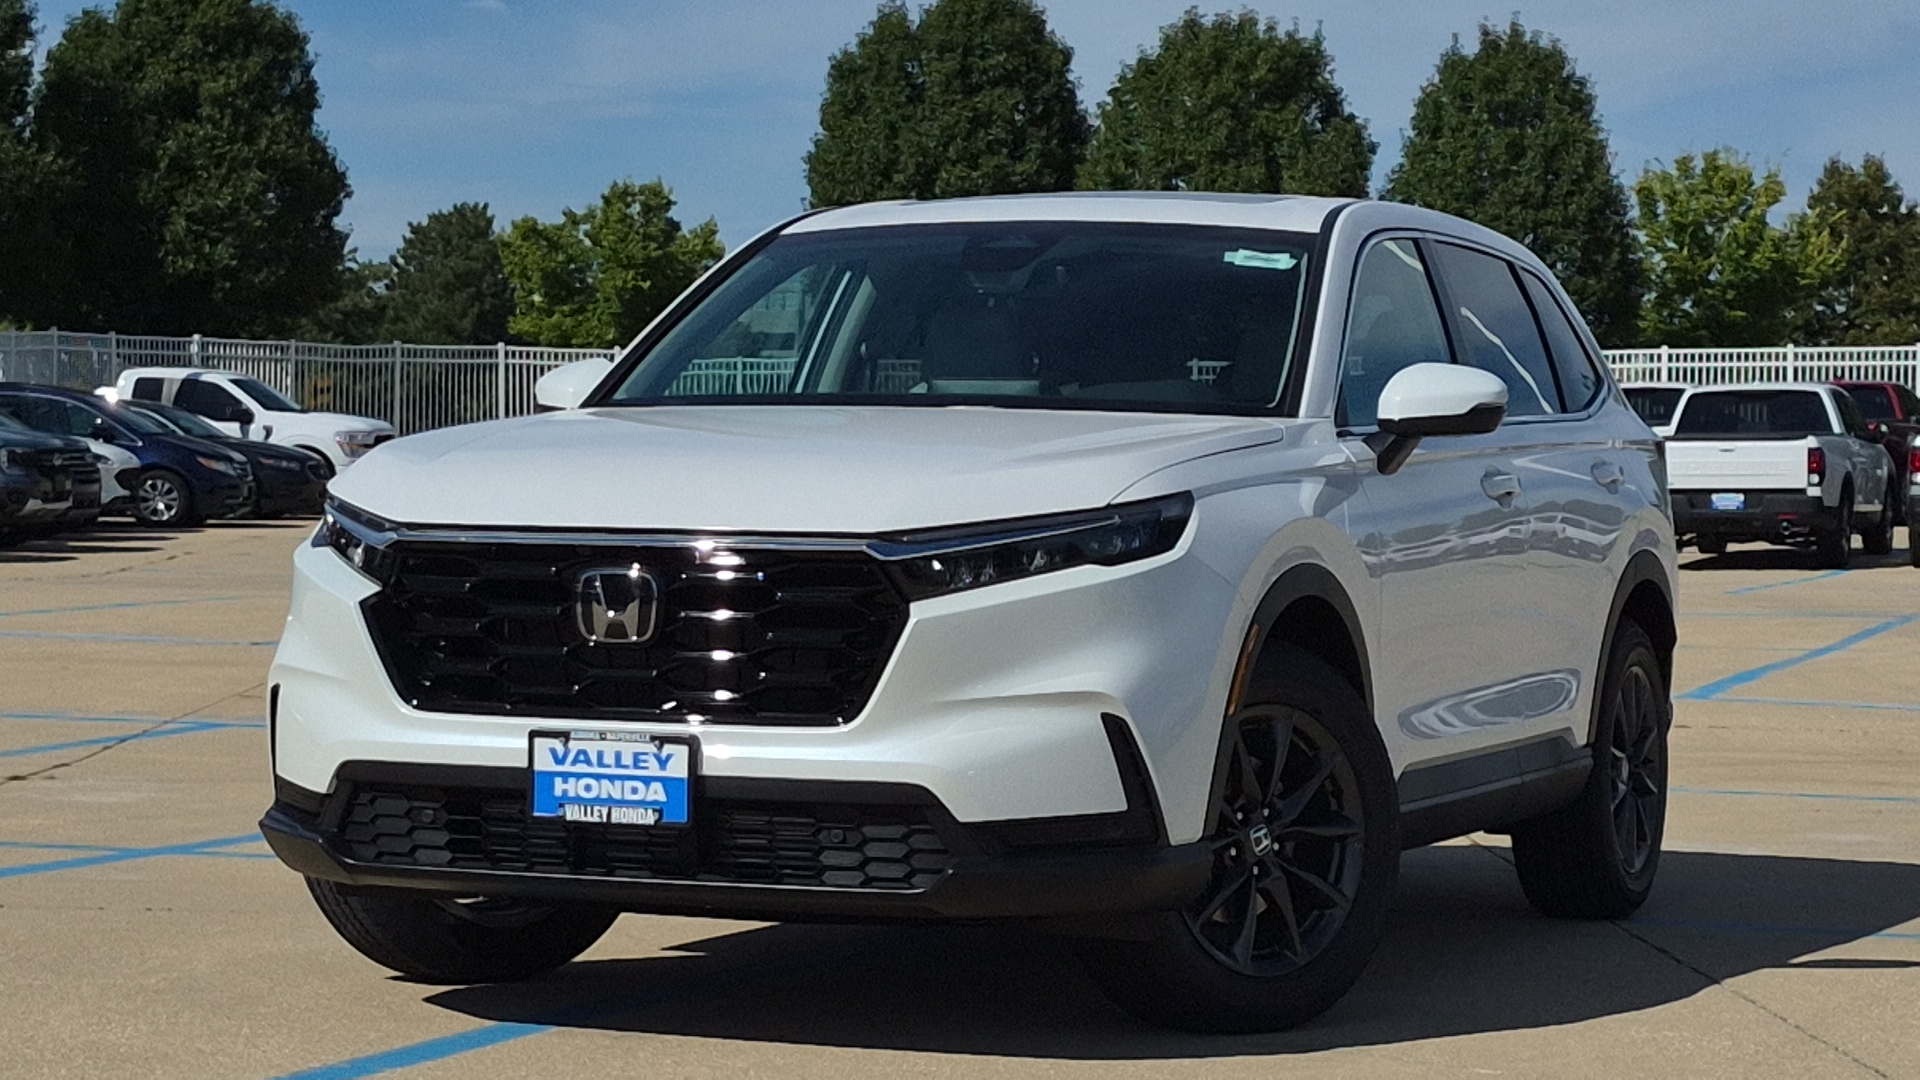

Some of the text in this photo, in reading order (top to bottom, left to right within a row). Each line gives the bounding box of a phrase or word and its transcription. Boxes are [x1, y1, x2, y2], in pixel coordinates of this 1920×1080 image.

[548, 747, 675, 771] VALLEY
[553, 776, 668, 802] HONDA
[564, 804, 655, 826] VALLEY HONDA
